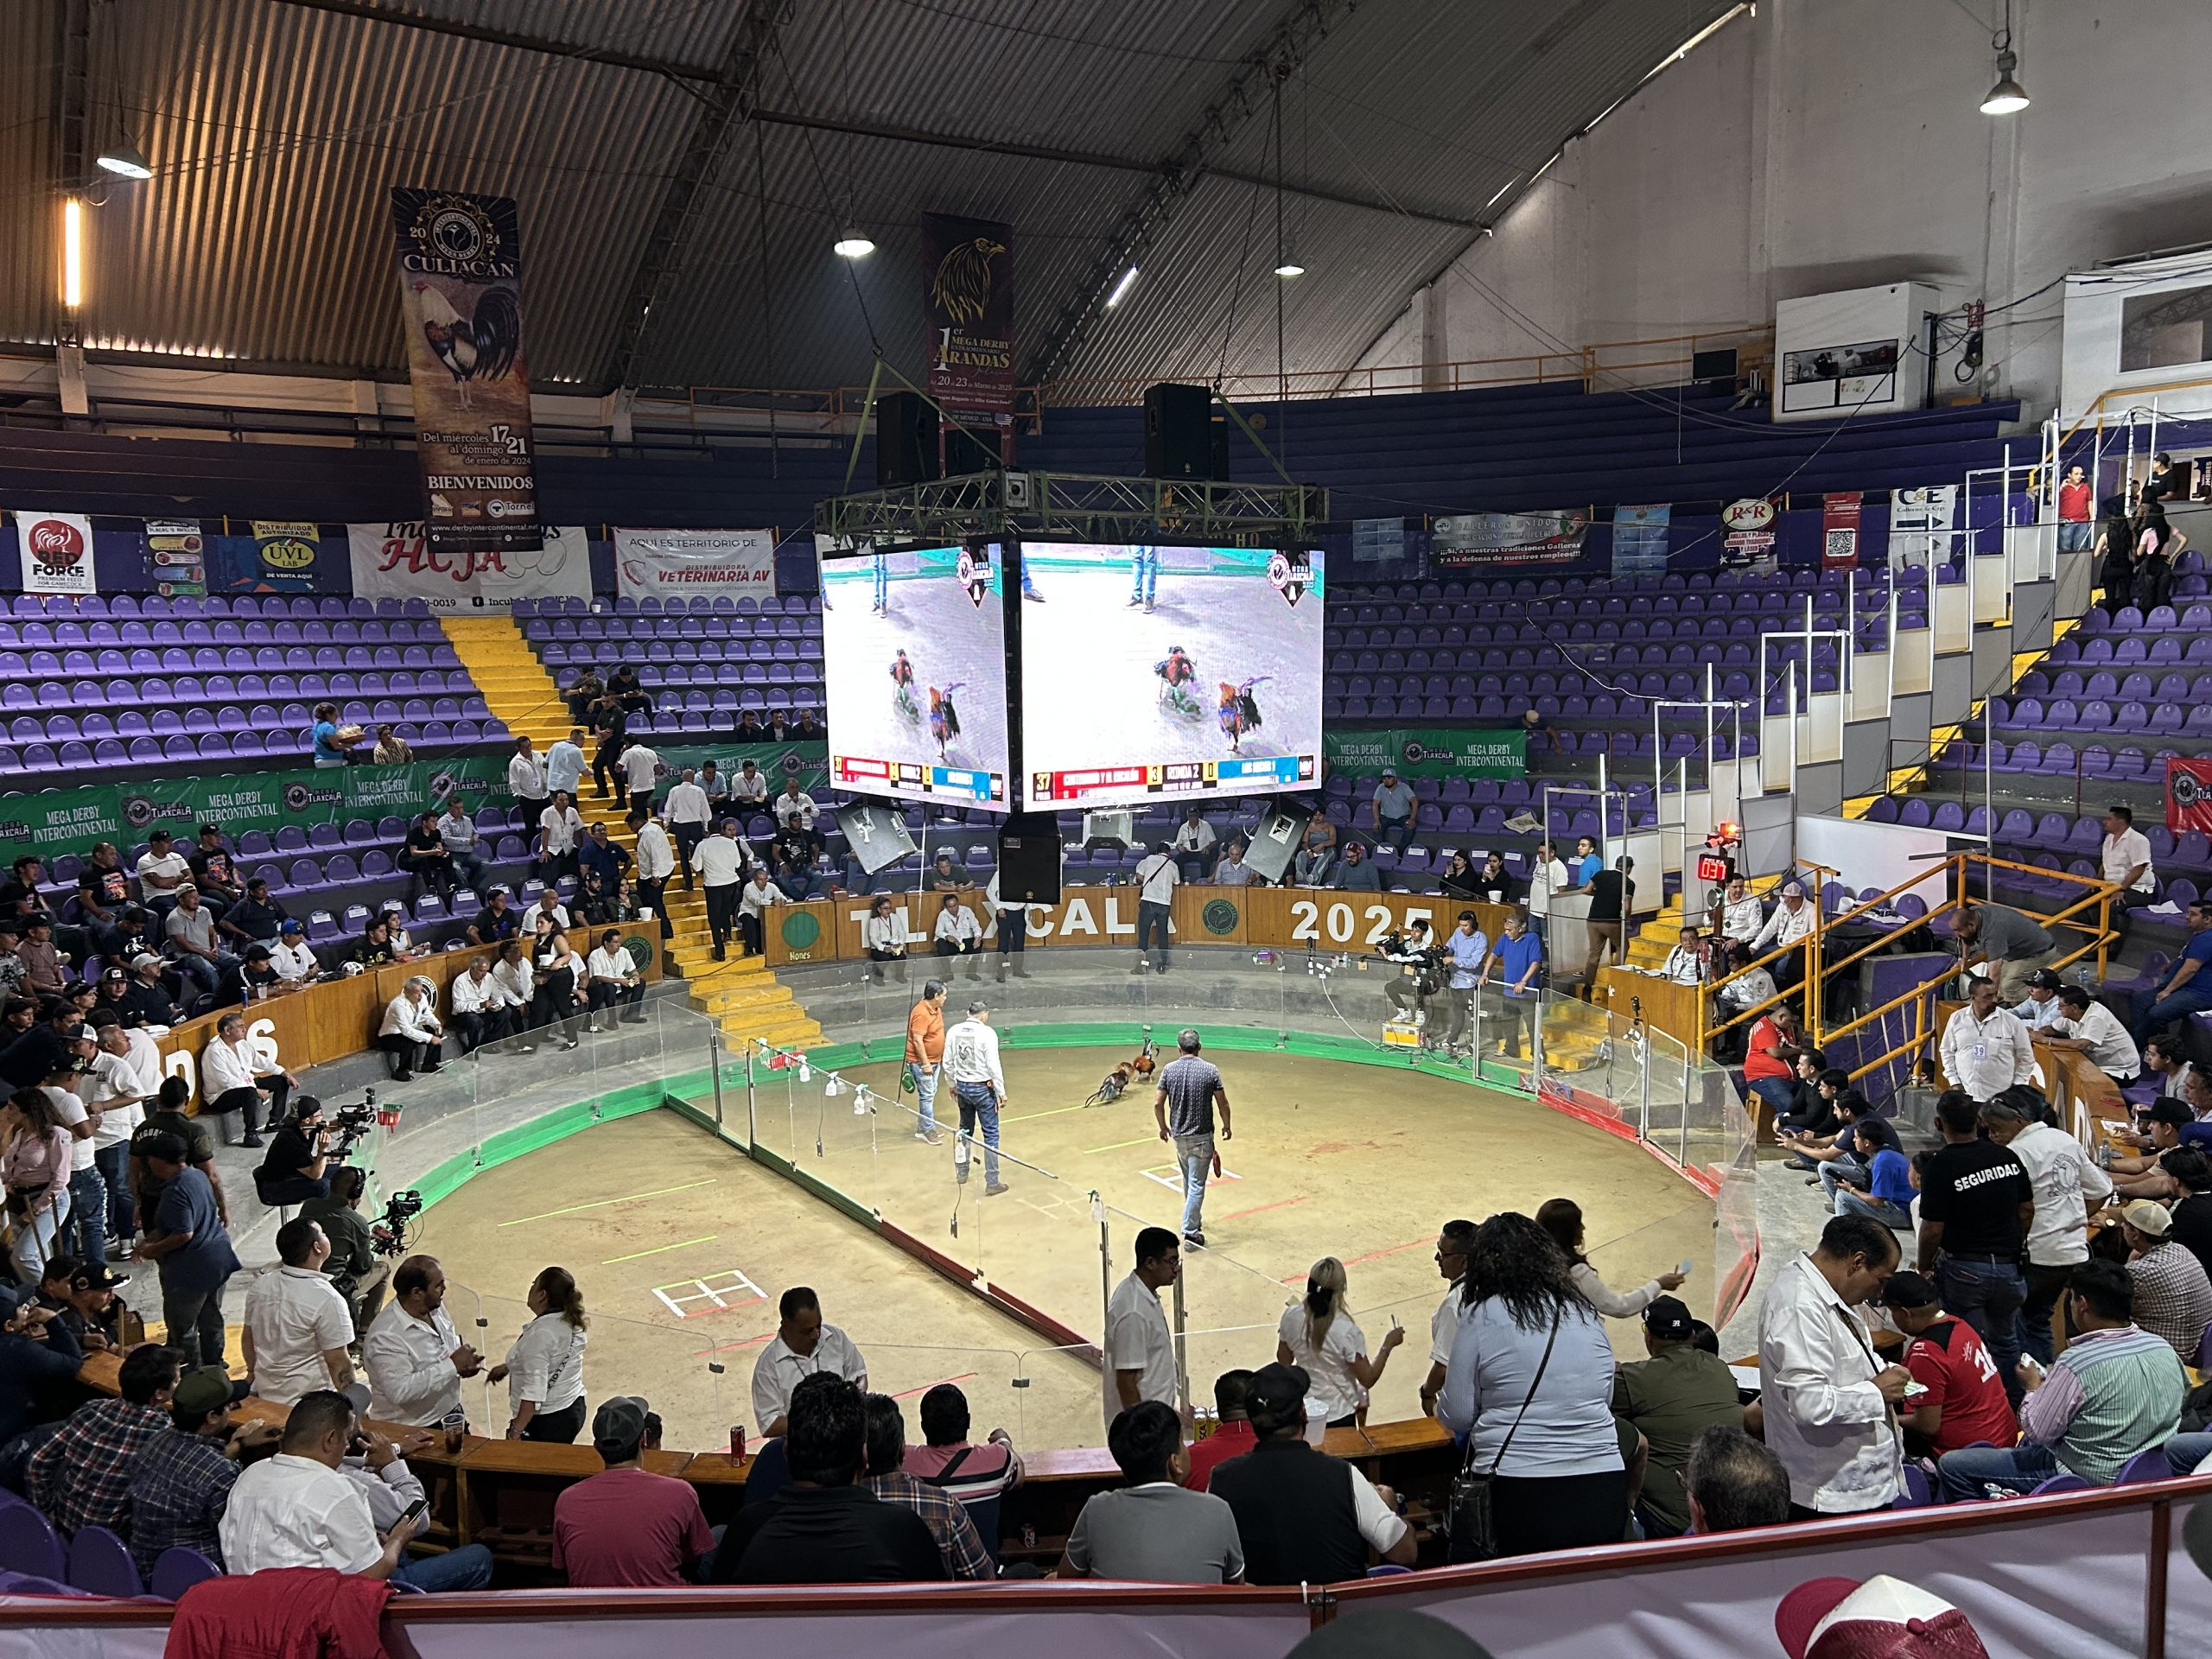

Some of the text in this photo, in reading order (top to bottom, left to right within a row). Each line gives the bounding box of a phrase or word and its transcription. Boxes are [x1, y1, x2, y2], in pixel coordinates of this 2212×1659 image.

[410, 226, 426, 239] 20
[486, 233, 500, 245] 24
[952, 336, 1011, 350] MEGA DERBY
[933, 345, 1010, 368] ARANDAS
[938, 375, 950, 386] 20
[955, 377, 968, 387] 23
[423, 425, 510, 443] Del miércoles 17
[450, 436, 526, 456] al domingo 21
[428, 475, 534, 490] BIENVENIDOS
[505, 501, 535, 512] Tornel
[432, 523, 539, 532] www.derbyintercontinental.net
[629, 537, 758, 548] AQUÍ ES TERRITORIO DE
[38, 550, 79, 565] RED
[269, 546, 308, 560] UVL
[33, 564, 85, 577] FORCE
[658, 569, 771, 582] VETERINARIA AV
[1340, 744, 1383, 754] MEGA DERBY
[1422, 751, 1453, 760] TLAXCALA
[1467, 744, 1510, 755] MEGA DERBY
[1329, 755, 1397, 766] INTERCONTINENTAL
[1456, 755, 1525, 767] INTERCONTINENTAL
[1152, 766, 1158, 782] 3
[1166, 765, 1199, 780] RONDA 2
[381, 779, 408, 792] DERBY
[454, 780, 487, 791] TLAXCALA
[1036, 772, 1052, 791] 37
[208, 791, 261, 808] MEGA DERBY
[308, 791, 342, 804] TLAXCALA
[346, 791, 424, 808] INTERCONTINENTAL
[47, 805, 99, 825] MEGA DERBY
[151, 805, 192, 818] TLAXCALA
[195, 802, 279, 823] INTERCONTINENTAL
[34, 818, 118, 843] INTERCONTINENTAL
[1701, 862, 1726, 880] 037
[1973, 1045, 1985, 1056] 39
[1954, 1163, 2020, 1192] SEGURIDAD
